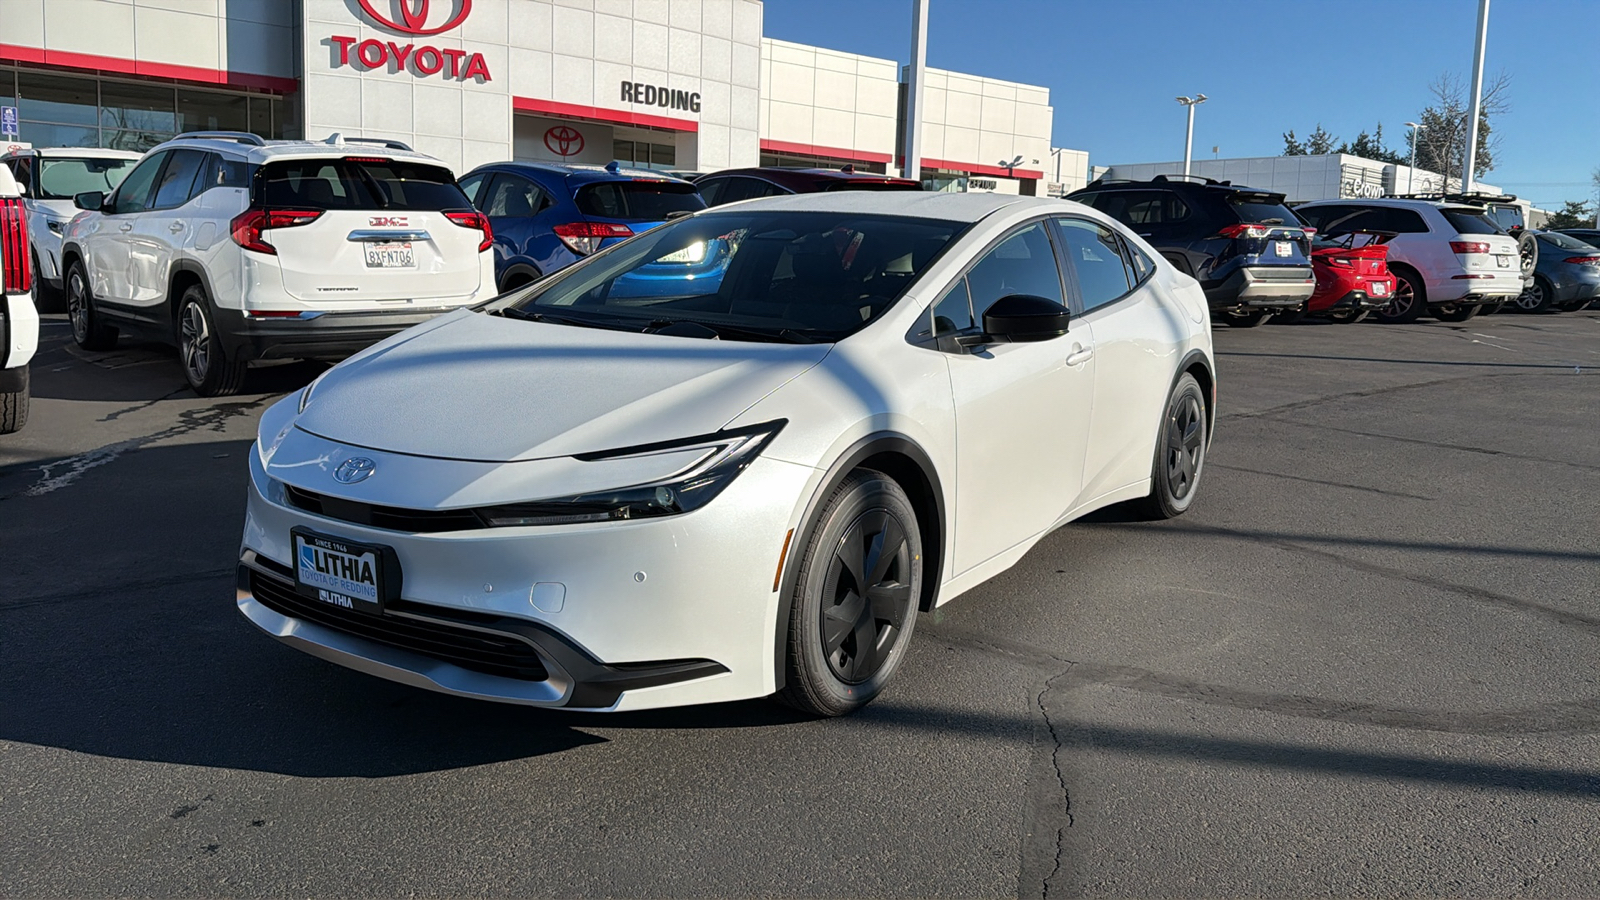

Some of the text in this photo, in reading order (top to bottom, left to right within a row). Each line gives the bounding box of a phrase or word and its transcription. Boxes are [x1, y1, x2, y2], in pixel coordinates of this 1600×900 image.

[331, 35, 492, 81] TOYOTA
[621, 80, 701, 113] REDDING
[368, 216, 409, 227] GMC
[369, 250, 412, 263] 8XFN706
[315, 539, 347, 552] SINCE 1946
[314, 549, 376, 586] LITHIA
[301, 569, 376, 597] TOYOTA OF REDDING
[327, 591, 353, 608] LITHIA
